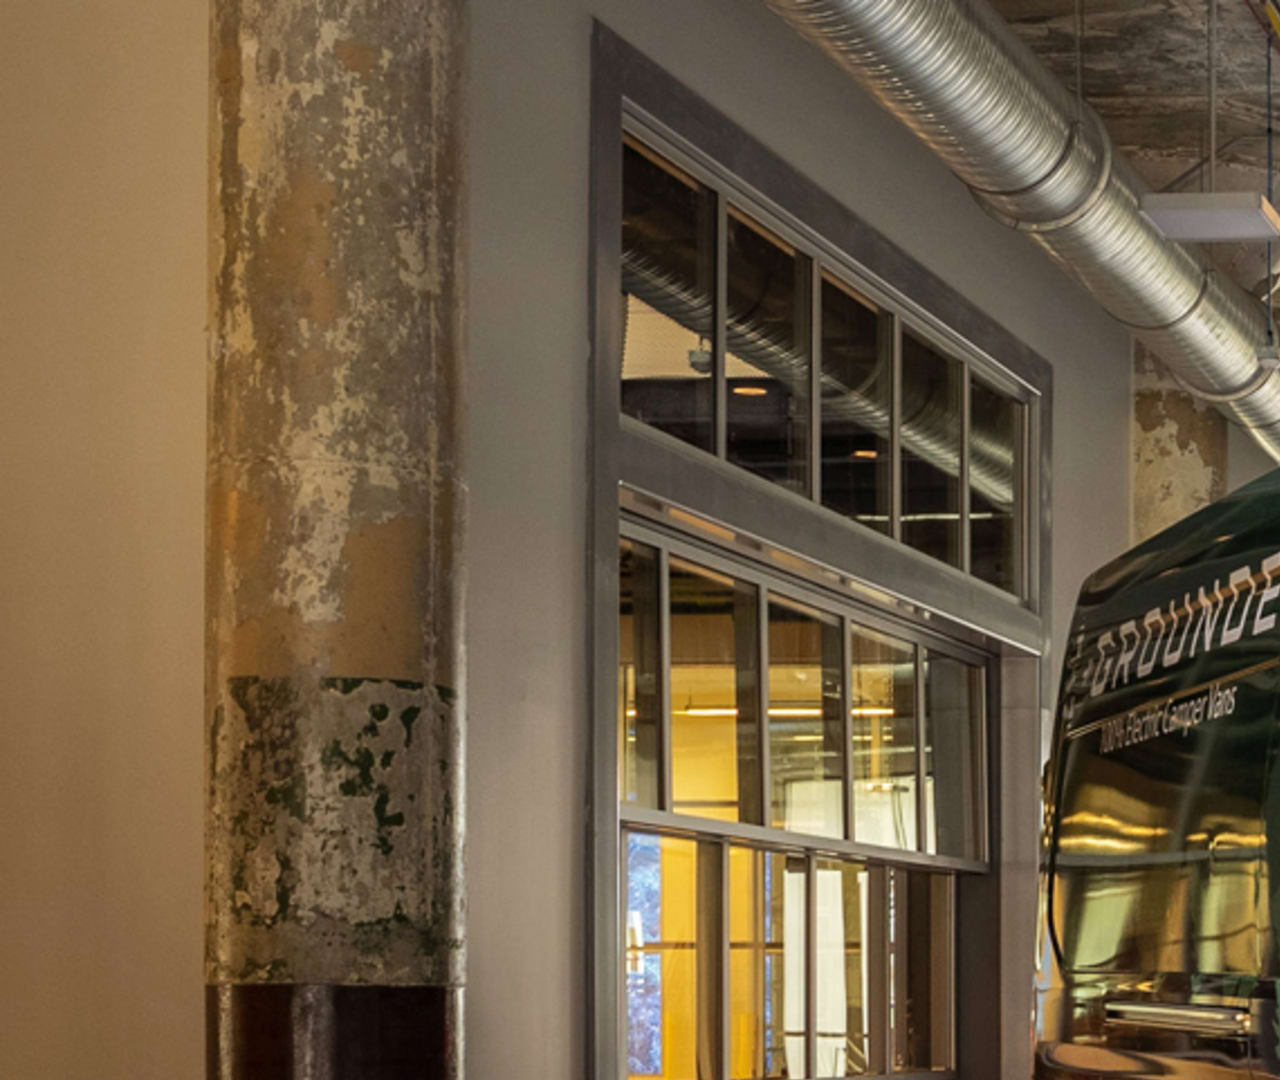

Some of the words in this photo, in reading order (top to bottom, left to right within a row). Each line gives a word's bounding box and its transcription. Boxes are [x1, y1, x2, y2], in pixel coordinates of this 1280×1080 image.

[1125, 704, 1163, 747] Electric
[1163, 698, 1208, 738] Camper
[1207, 683, 1238, 720] Vans
